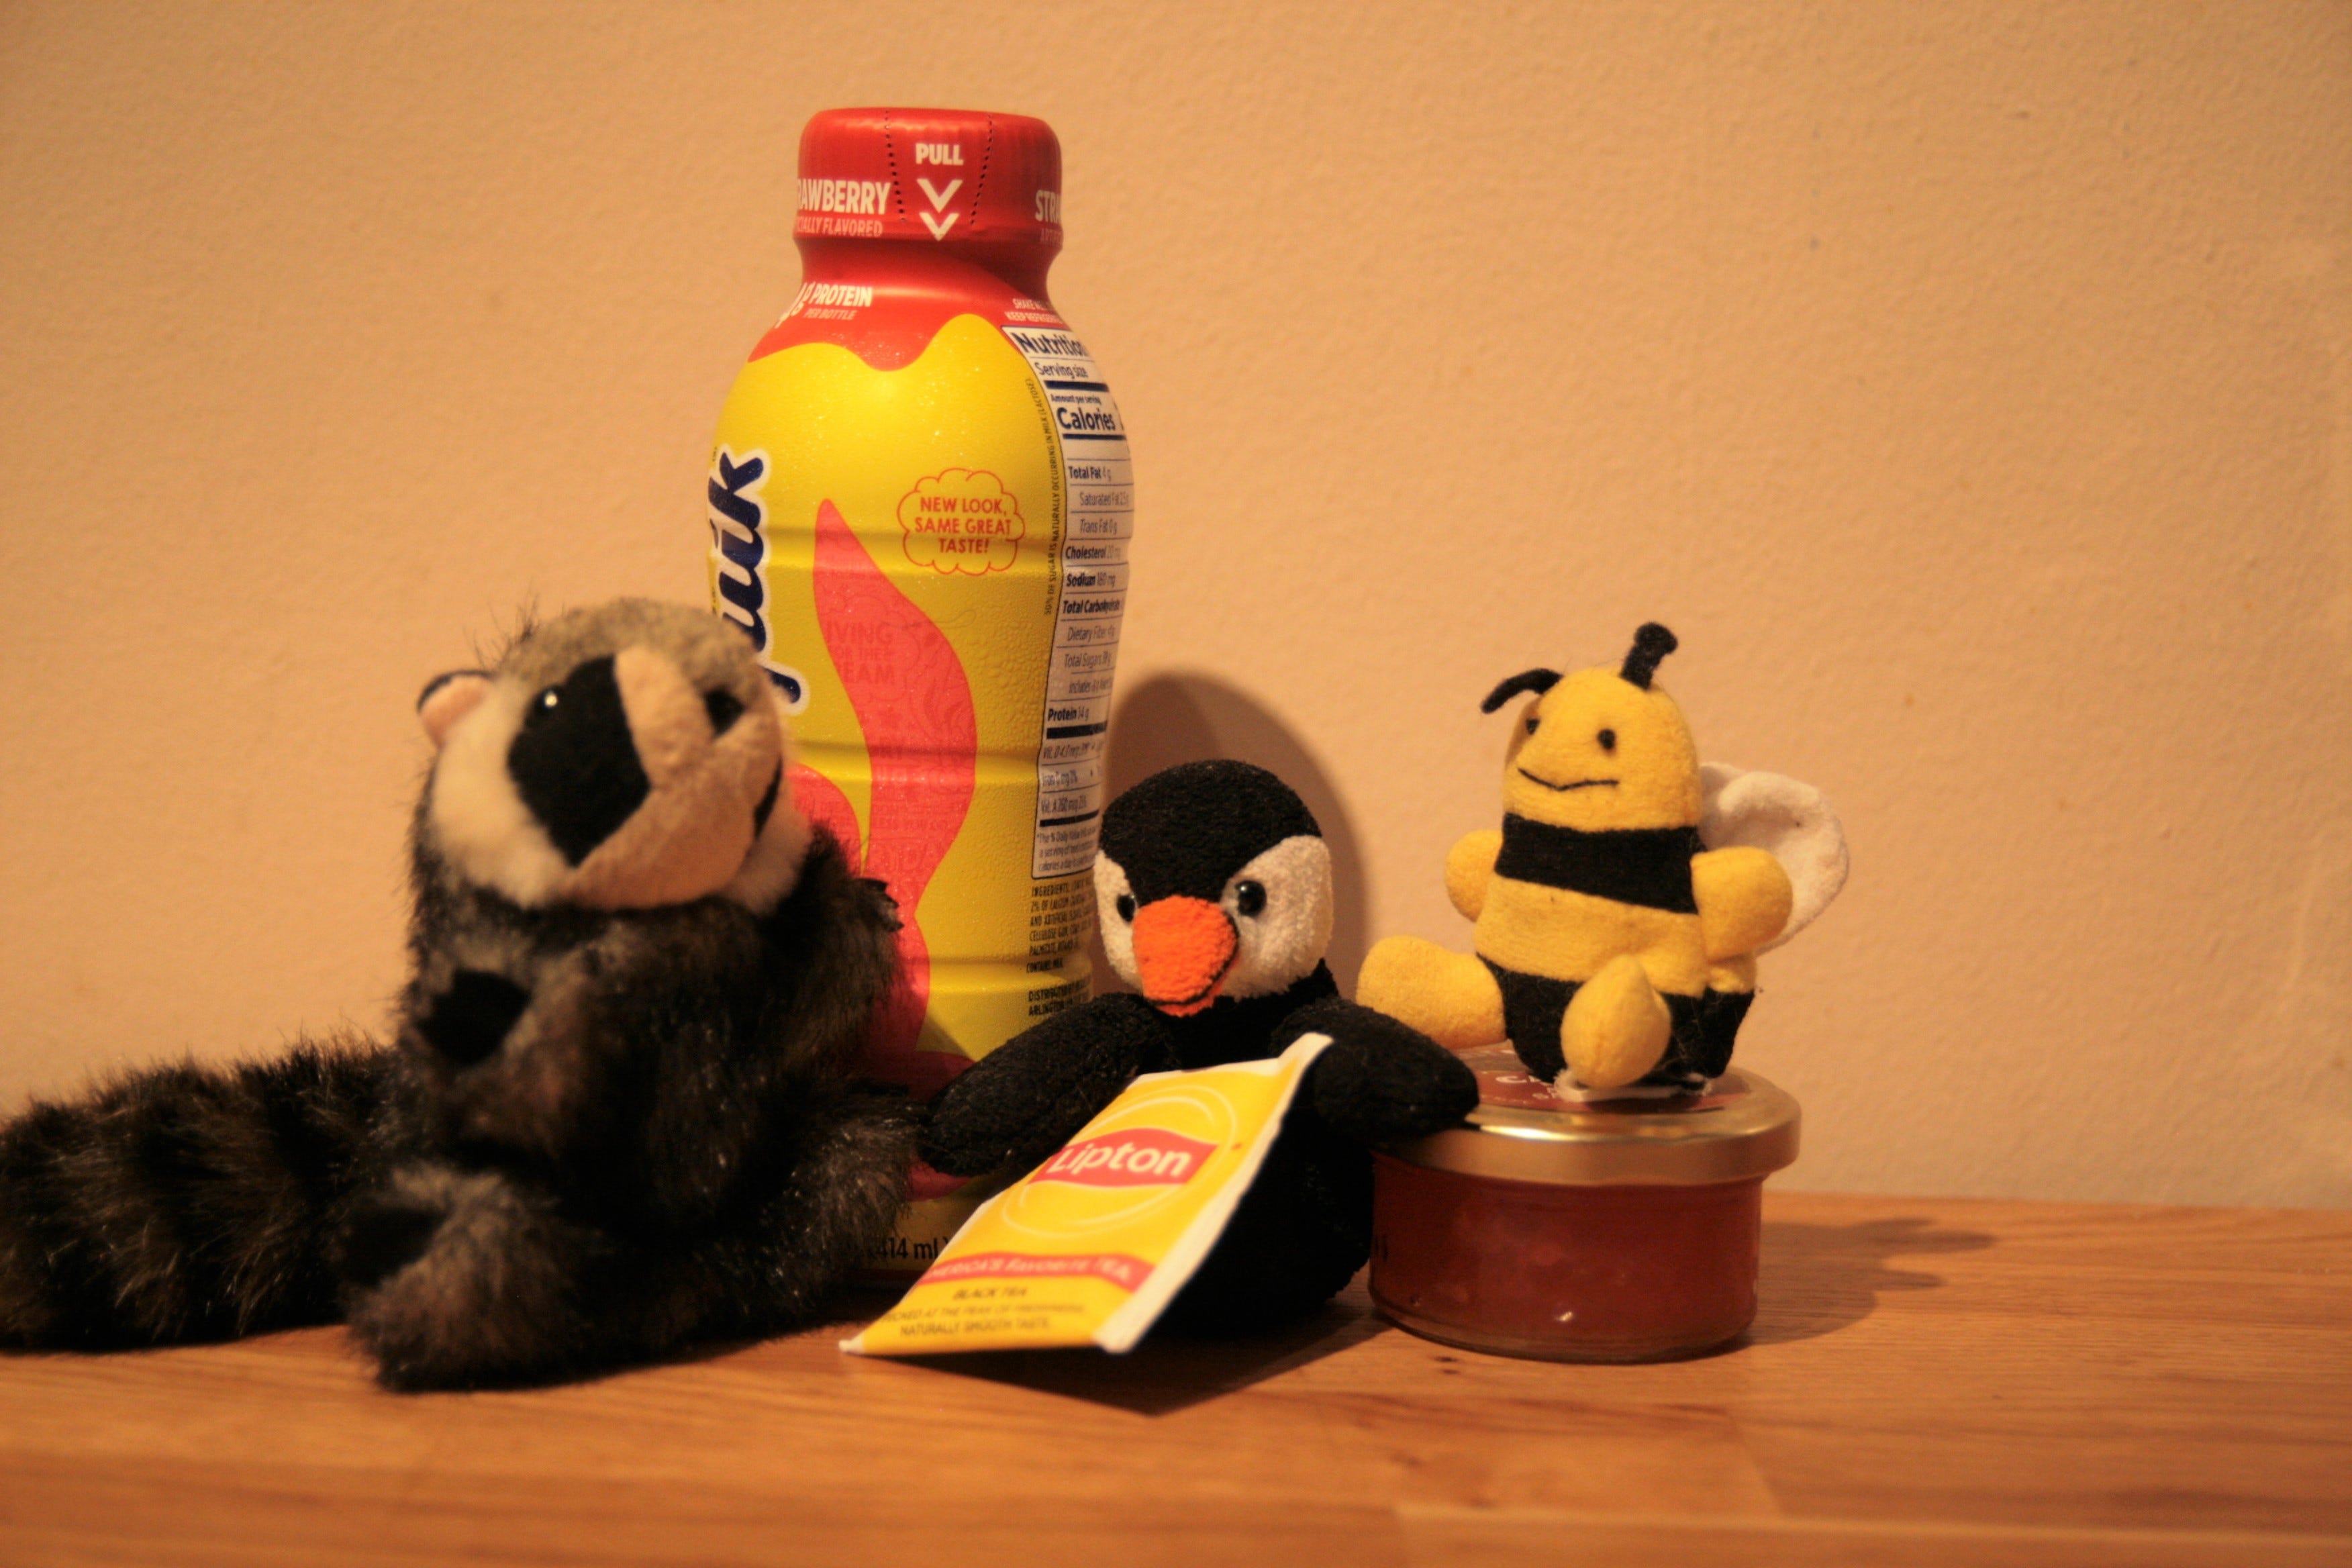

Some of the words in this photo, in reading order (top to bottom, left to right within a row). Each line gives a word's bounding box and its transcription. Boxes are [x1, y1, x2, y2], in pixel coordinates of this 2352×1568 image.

[916, 143, 964, 166] PULL
[822, 217, 883, 238] FLAVORED
[807, 283, 873, 307] PROTEIN
[819, 309, 858, 321] BOTTLE
[1034, 362, 1075, 379] Serving
[1073, 367, 1089, 379] size
[1050, 394, 1074, 403] Amount
[1074, 395, 1085, 406] per
[1040, 417, 1051, 434] MILK
[1057, 407, 1116, 431] Calories
[1046, 435, 1054, 444] IN
[1048, 446, 1059, 491] OCCURRING
[1068, 466, 1089, 479] Total
[1090, 467, 1101, 479] Fat
[920, 497, 957, 513] NEW
[962, 498, 1006, 516] LOOK,
[1079, 493, 1111, 506] Saturated
[1051, 493, 1060, 542] NATURALLY
[915, 517, 960, 534] SAME
[965, 519, 1012, 535] GREAT
[1080, 520, 1098, 534] Trans
[1098, 519, 1108, 533] Fat
[938, 538, 990, 554] TASTE!
[1051, 543, 1058, 551] IS
[1065, 546, 1106, 560] Cholesterol
[1048, 552, 1057, 582] SUGAR
[708, 451, 802, 705] uik
[1066, 573, 1096, 587] Sodium
[1048, 583, 1056, 595] OF
[1063, 599, 1083, 615] Total
[1067, 626, 1093, 642] Dietary
[1065, 653, 1083, 669] Total
[1048, 707, 1077, 721] Protein
[1046, 1142, 1192, 1177] Lipton
[871, 1236, 909, 1259] 414
